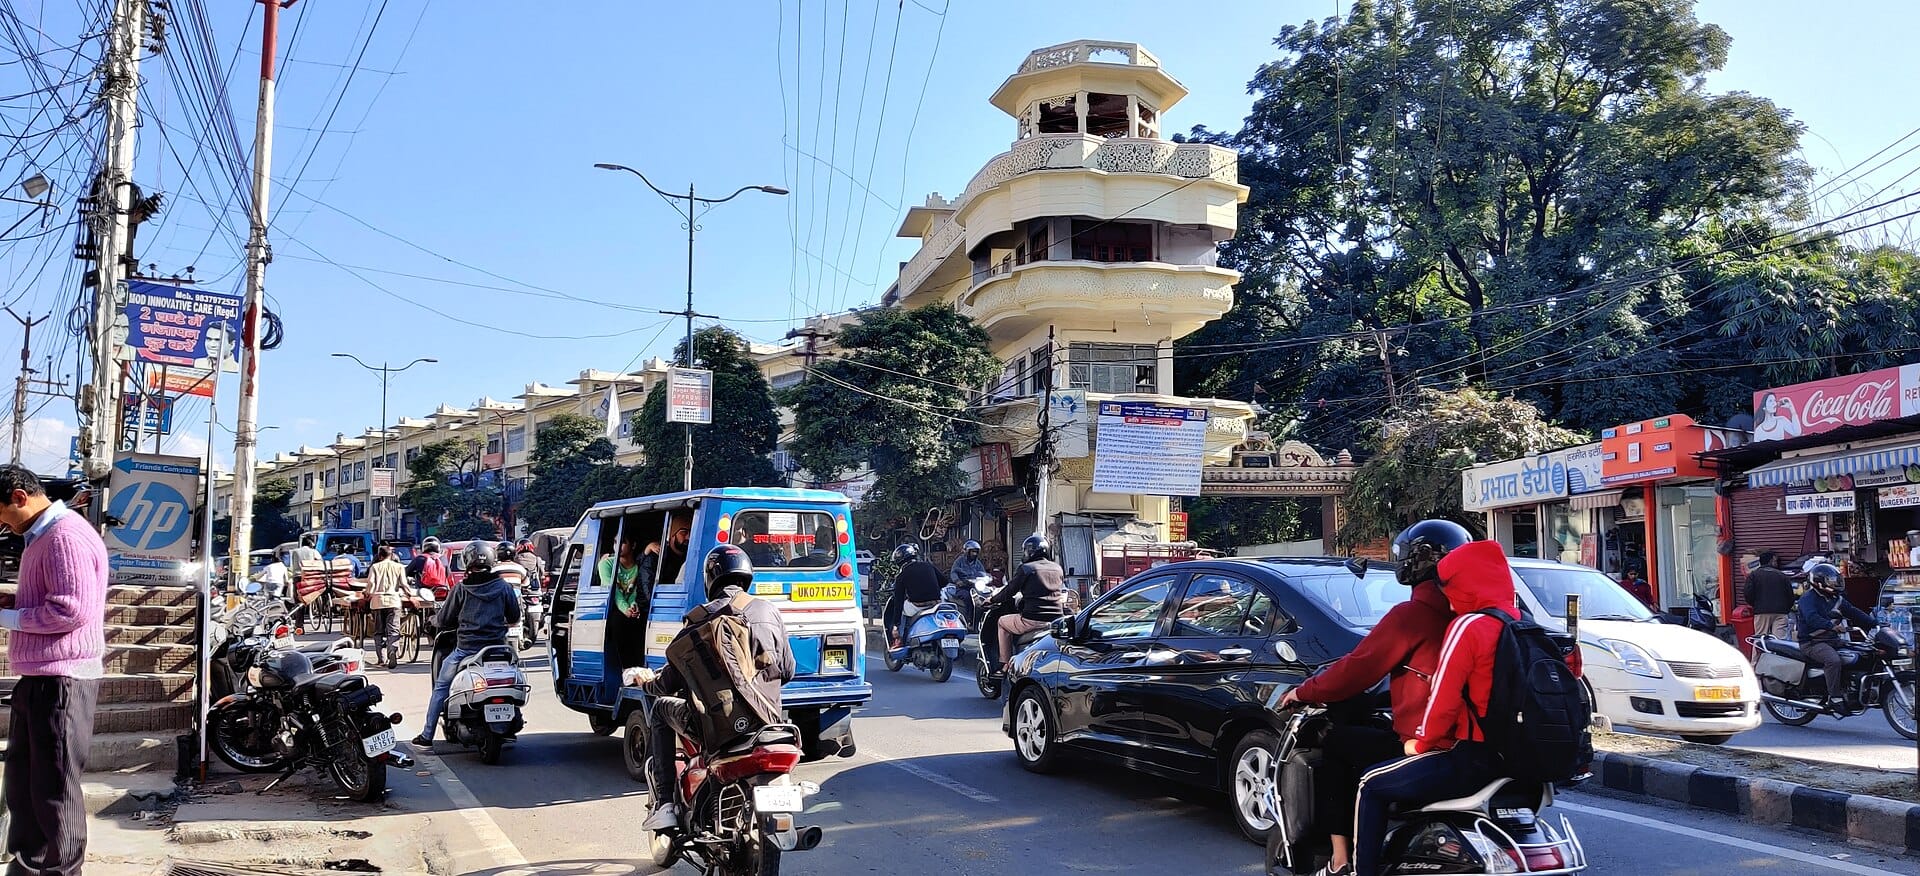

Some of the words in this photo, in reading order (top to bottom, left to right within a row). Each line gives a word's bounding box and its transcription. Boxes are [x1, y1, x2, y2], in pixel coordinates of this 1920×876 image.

[175, 291, 193, 300] Mob.
[147, 295, 192, 312] INNOVATIVE
[193, 302, 213, 314] CARE
[213, 305, 239, 320] (Regd.)
[139, 306, 151, 320] 2
[187, 313, 206, 327] में
[168, 339, 198, 352] करें
[1801, 379, 1897, 427] Coca-Cola
[135, 463, 161, 471] Friends
[162, 465, 193, 474] Complex
[1480, 473, 1518, 505] प्रभात
[1520, 455, 1551, 496] डेरी
[1888, 474, 1904, 482] POINT
[1880, 498, 1905, 507] BURGER
[115, 482, 184, 550] hp
[798, 586, 853, 598] UK07TA5714
[372, 731, 389, 743] UK07
[1396, 862, 1442, 870] Activa
